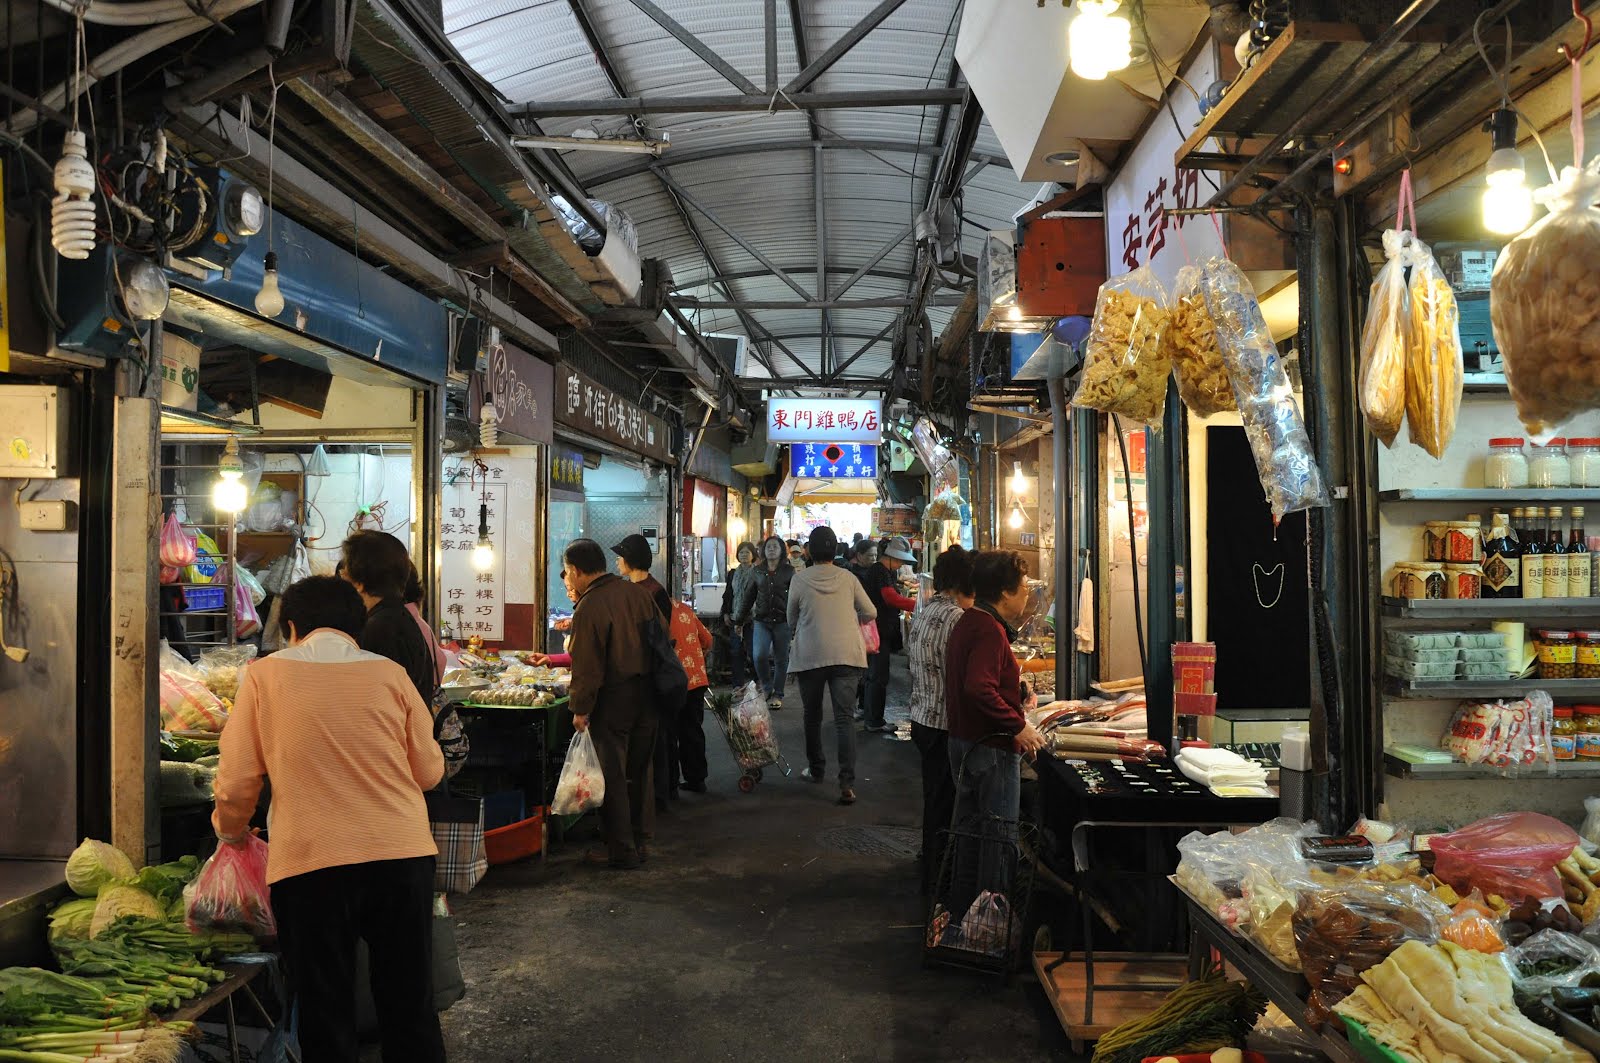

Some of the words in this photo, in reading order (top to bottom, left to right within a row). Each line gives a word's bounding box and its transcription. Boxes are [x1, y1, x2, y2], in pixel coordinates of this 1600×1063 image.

[772, 409, 878, 431] 東門雞鴨店
[796, 465, 873, 478] 五星中藥行
